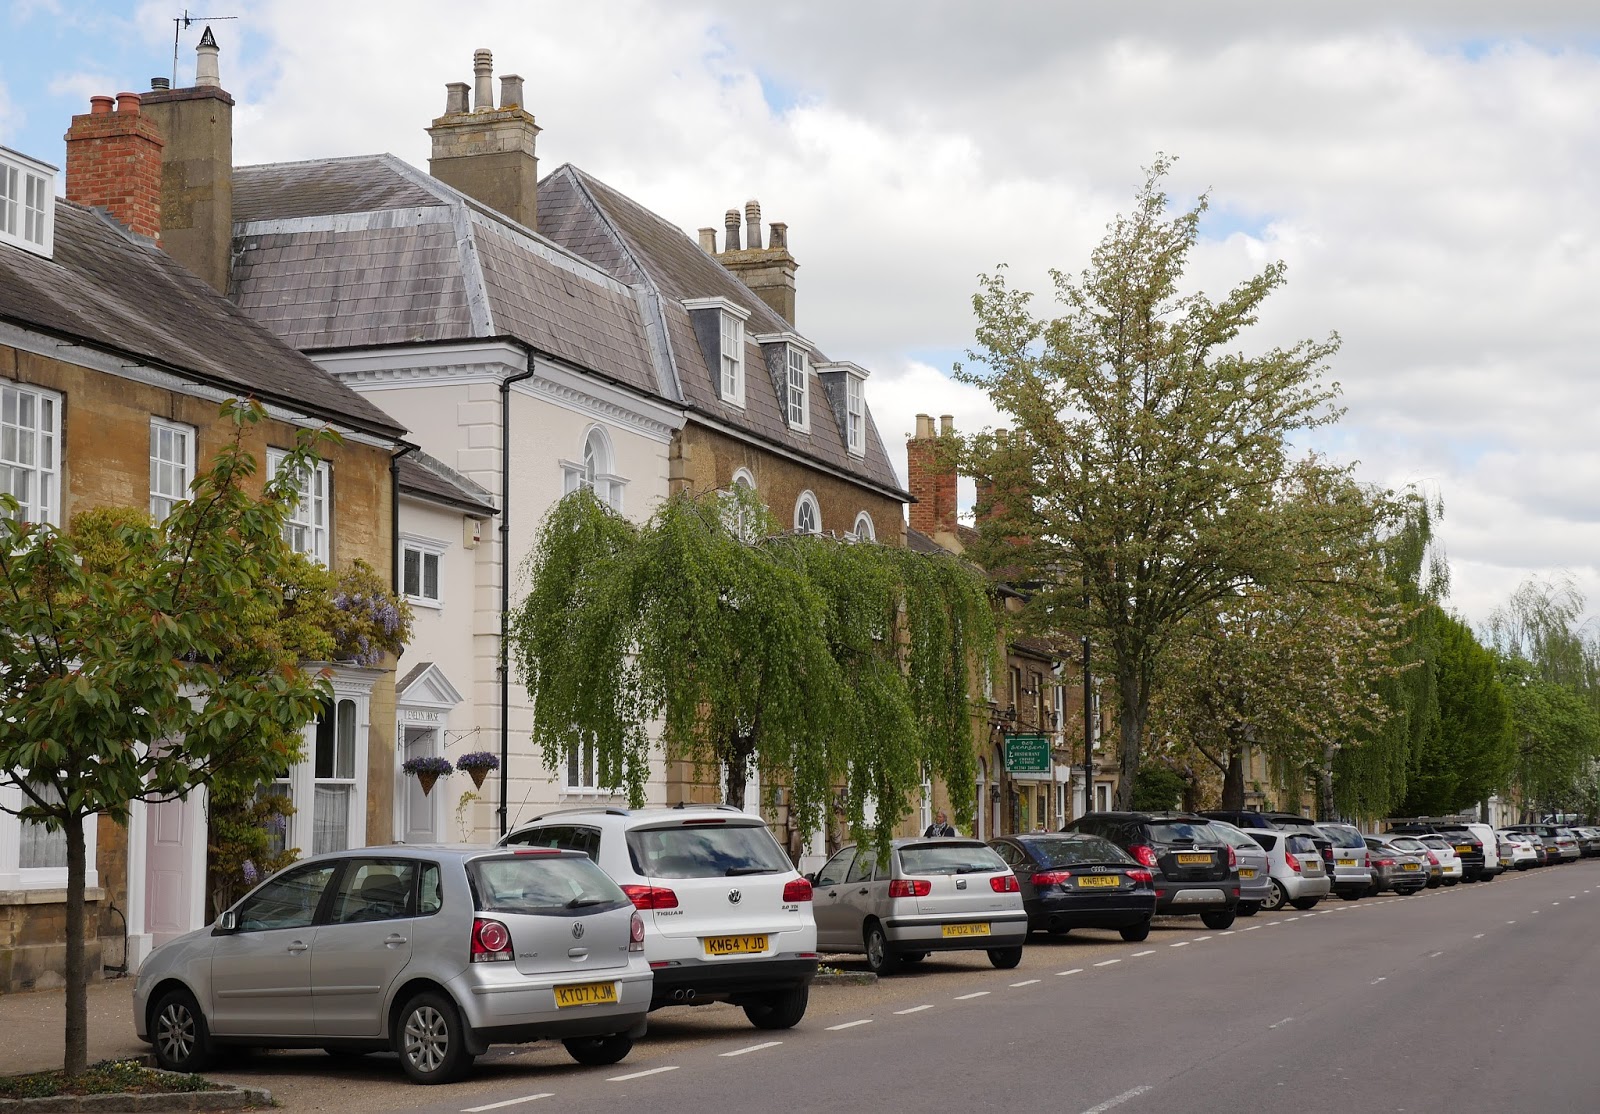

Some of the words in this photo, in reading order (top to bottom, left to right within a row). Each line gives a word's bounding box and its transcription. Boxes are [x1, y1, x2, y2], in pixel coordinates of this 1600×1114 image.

[408, 711, 425, 720] EVELYN
[426, 712, 439, 721] HOUSE
[947, 925, 969, 935] AF02
[709, 938, 740, 952] KM64
[742, 937, 765, 950] YJD
[559, 987, 590, 1003] KT07
[591, 985, 614, 1000] XJM
